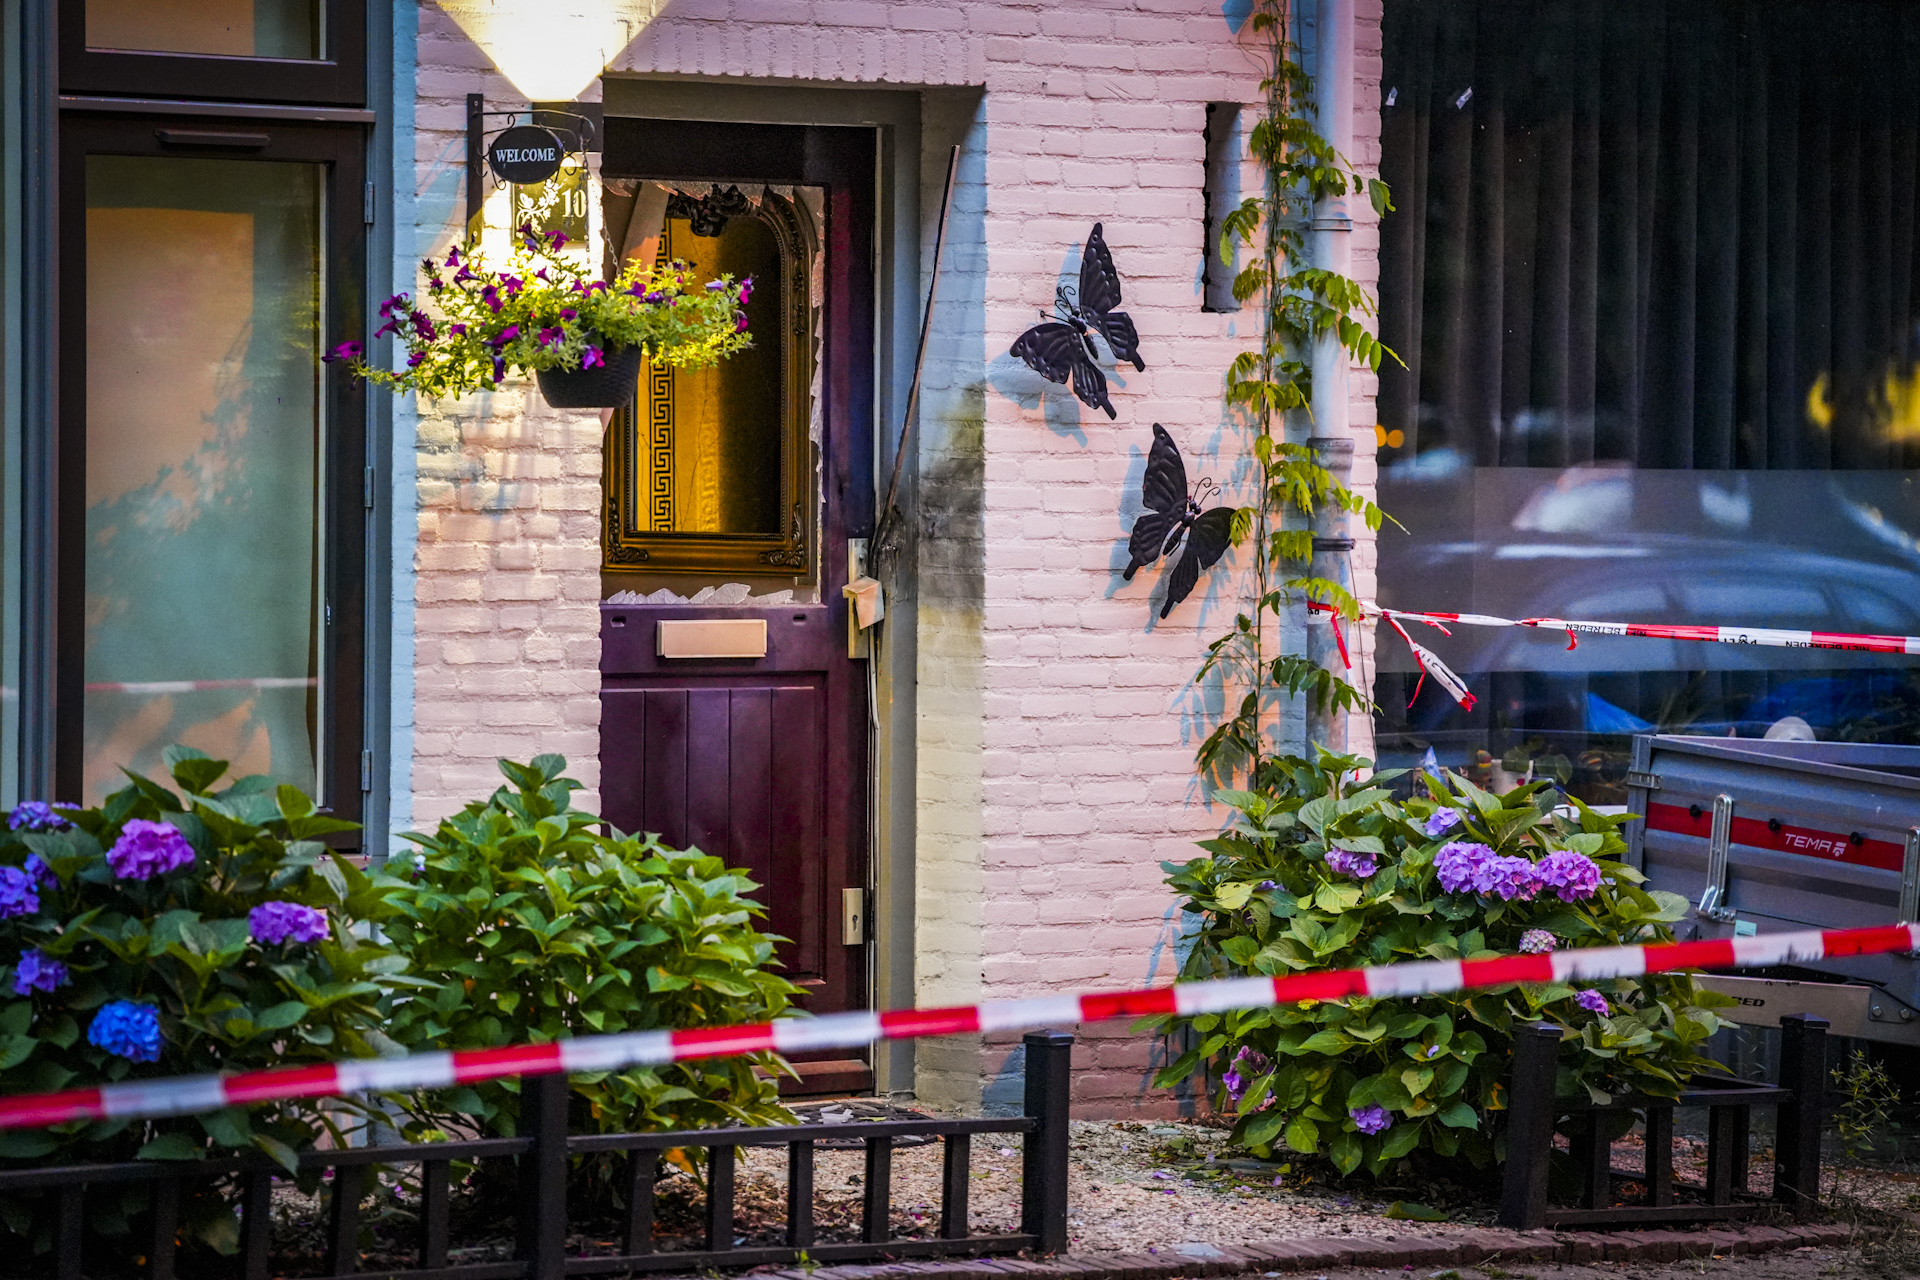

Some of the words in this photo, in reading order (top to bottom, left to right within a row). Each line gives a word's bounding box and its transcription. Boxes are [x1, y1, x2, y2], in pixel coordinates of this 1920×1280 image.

[495, 147, 556, 163] WELCOME
[561, 187, 587, 218] 10
[1565, 623, 1621, 635] BETREDEN
[1785, 833, 1832, 852] TEMA
